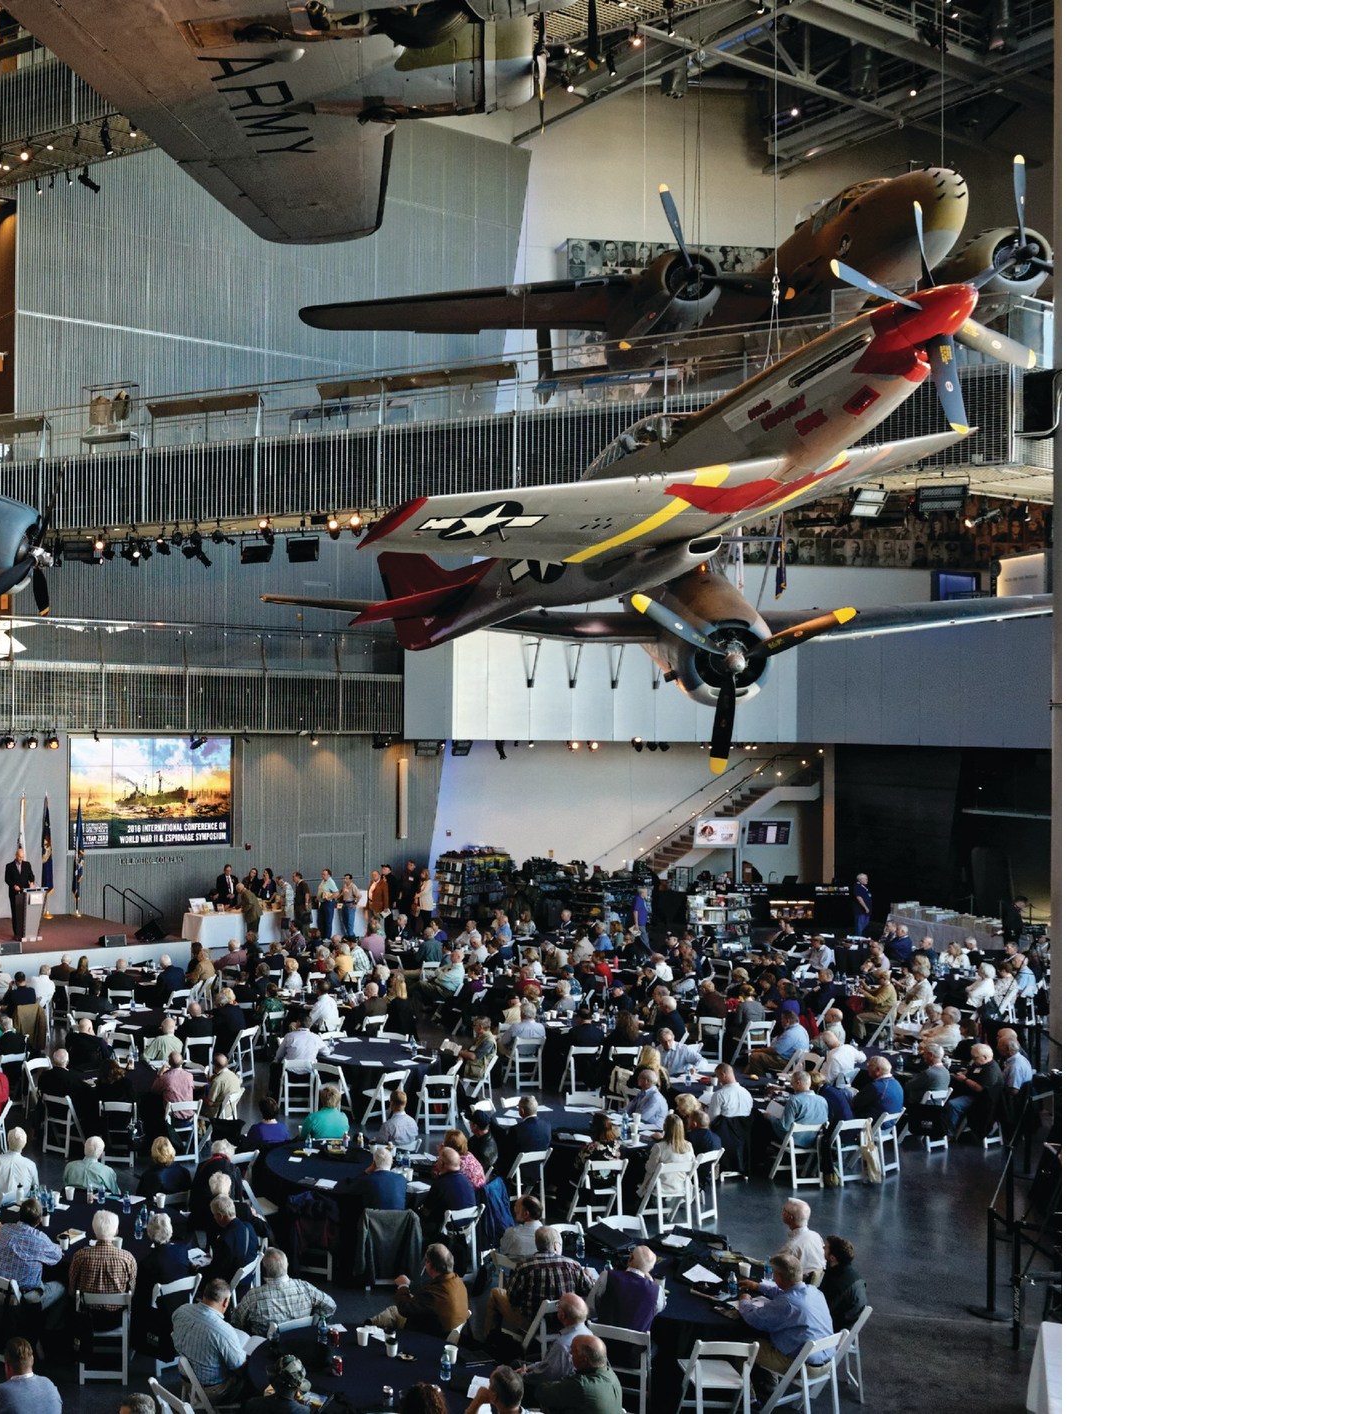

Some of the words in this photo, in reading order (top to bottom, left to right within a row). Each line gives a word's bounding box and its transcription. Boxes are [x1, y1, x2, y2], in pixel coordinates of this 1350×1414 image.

[197, 56, 318, 154] ARMY
[127, 825, 141, 833] 2016
[142, 823, 183, 832] INTERNATIONAL
[183, 822, 218, 831] CONFERENCE
[218, 822, 227, 830] ON
[119, 835, 140, 844] WORLD
[140, 835, 153, 843] WAR
[159, 834, 164, 842] &
[164, 833, 195, 842] ESPIONAGE
[195, 832, 227, 841] SYMPOSIUM
